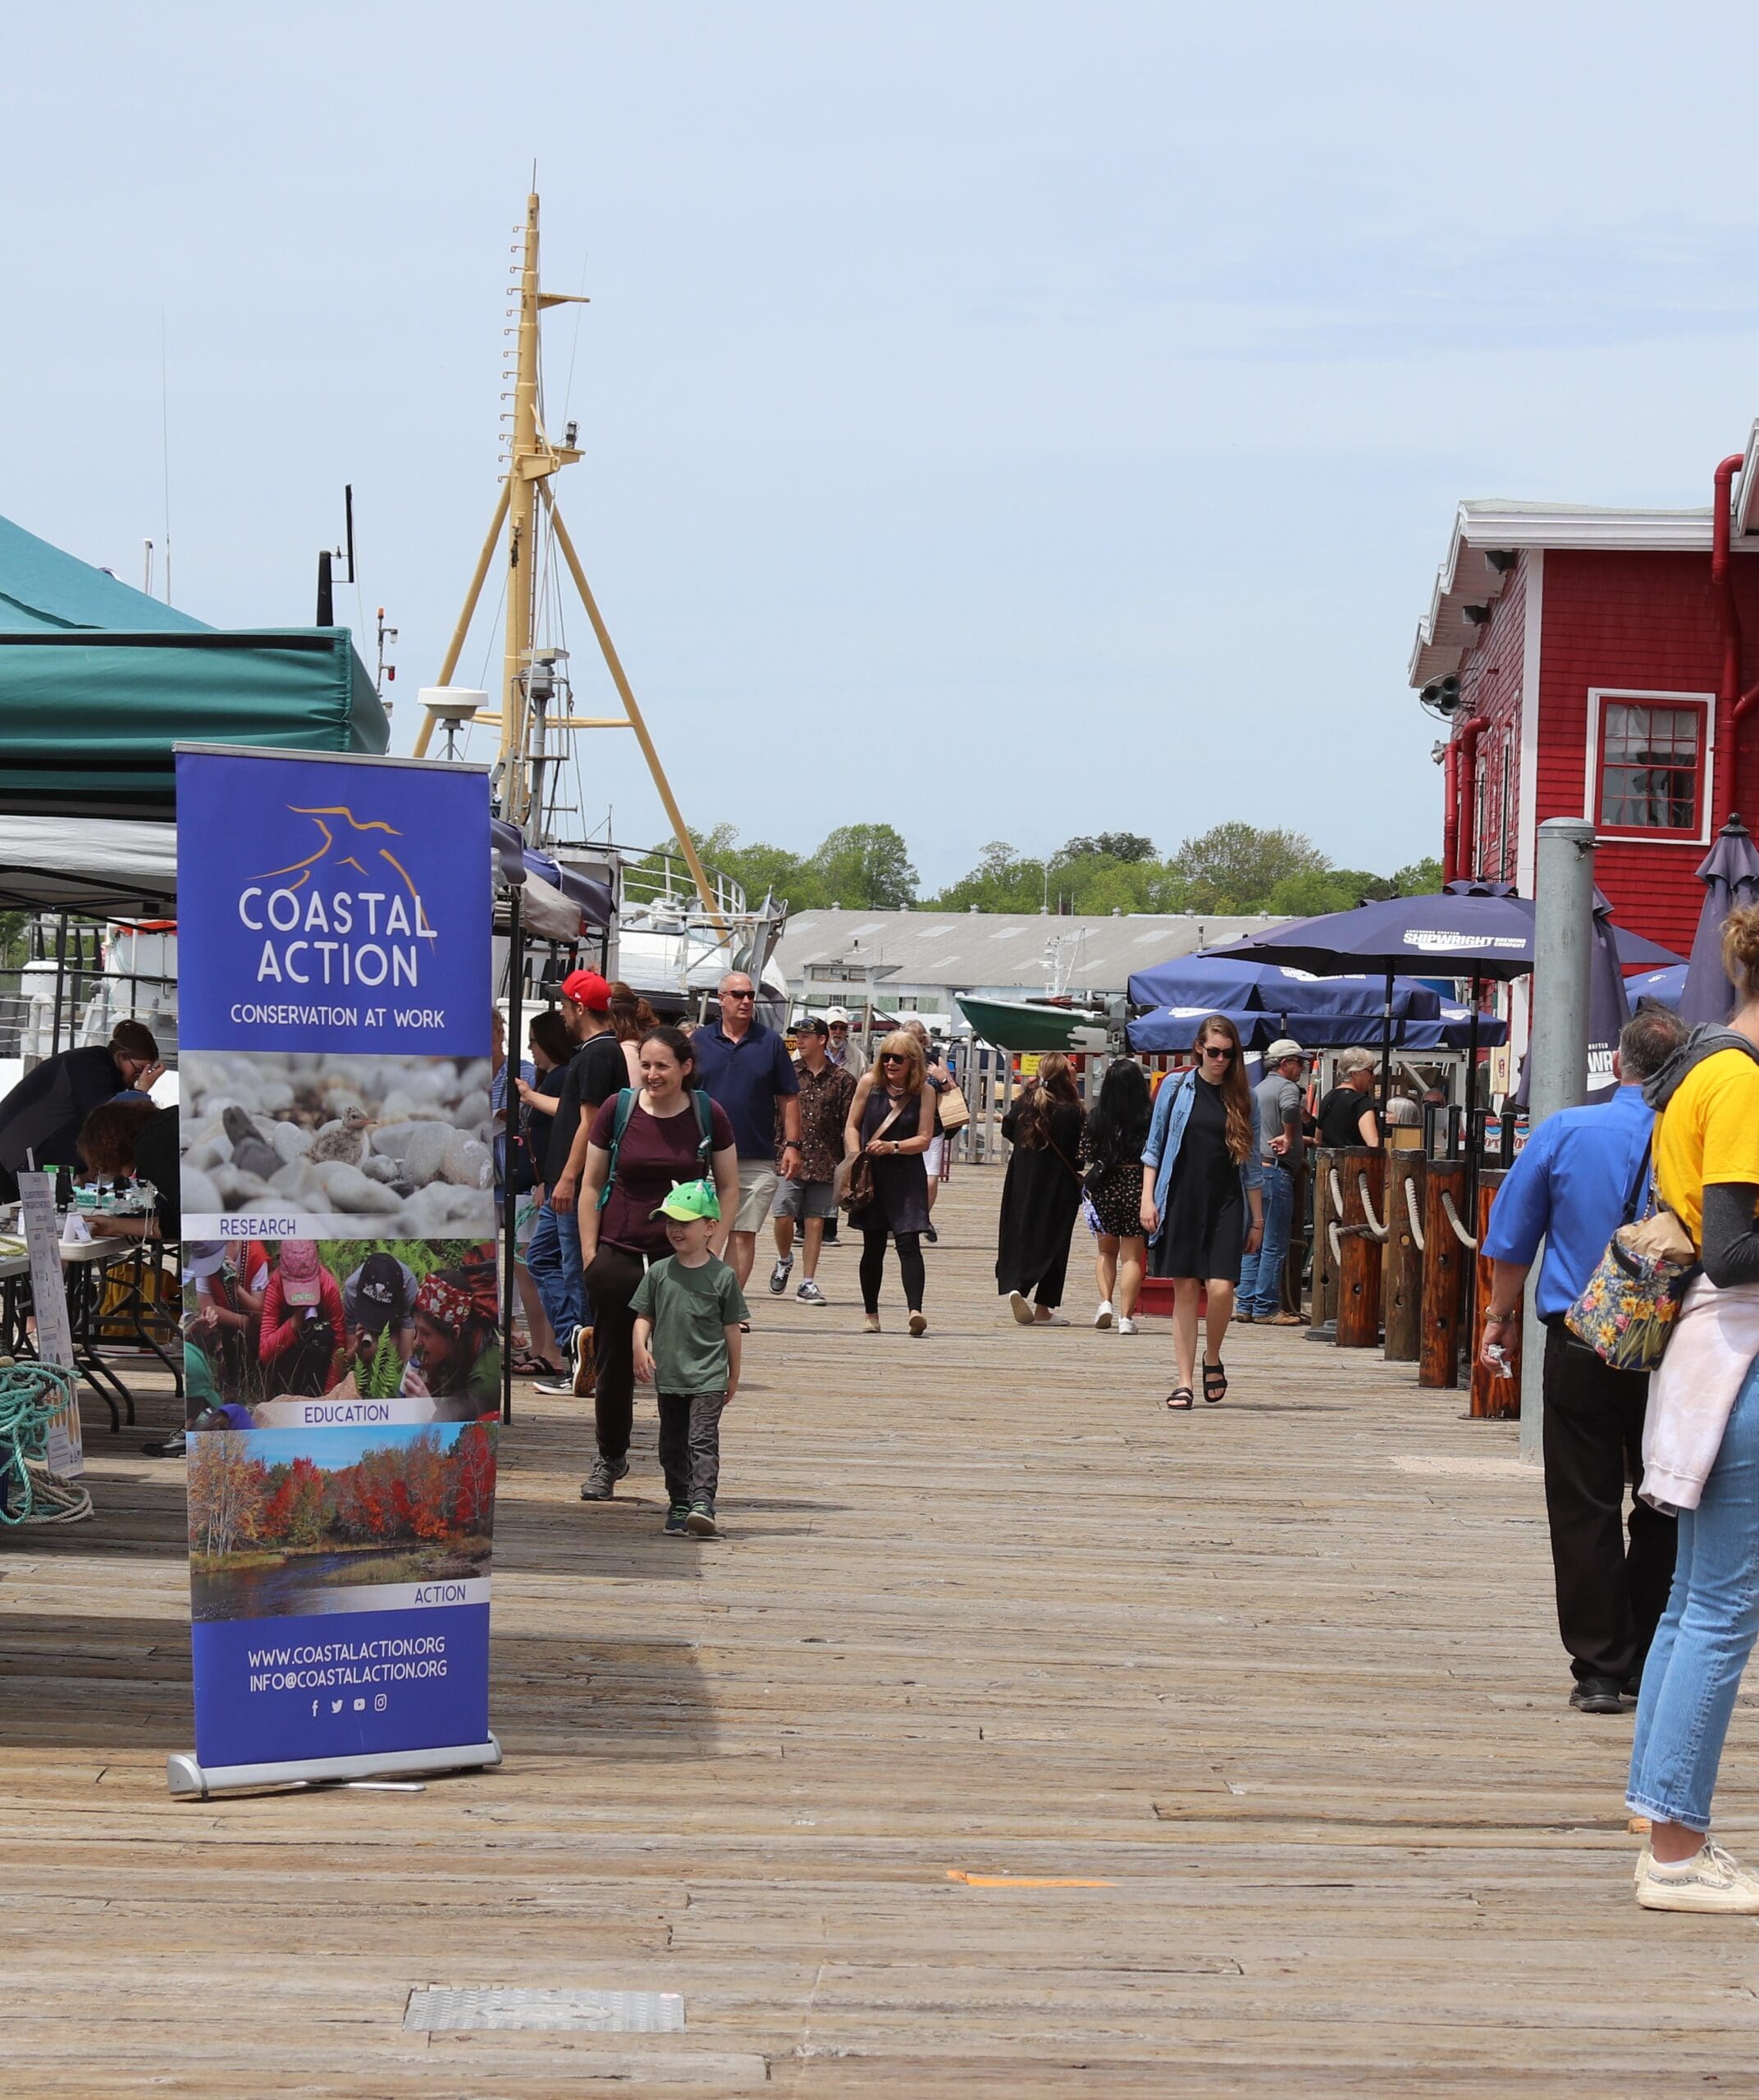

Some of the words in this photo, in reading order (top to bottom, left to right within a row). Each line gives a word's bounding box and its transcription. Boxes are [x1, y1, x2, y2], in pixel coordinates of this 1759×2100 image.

[239, 887, 438, 938] COASTAL
[1403, 933, 1495, 945] SHIPWRIGHT
[257, 939, 418, 988] ACTION
[231, 1003, 358, 1027] CONSERVATION
[364, 1008, 386, 1027] AT
[394, 1009, 445, 1029] WORK
[220, 1218, 296, 1235] RESEARCH
[304, 1404, 389, 1423] EDUCATION
[414, 1584, 466, 1605] ACTION
[248, 1636, 445, 1668] WWW.COASTALACTION.ORG
[250, 1659, 448, 1692] INFO@COASTALACTION.ORG
